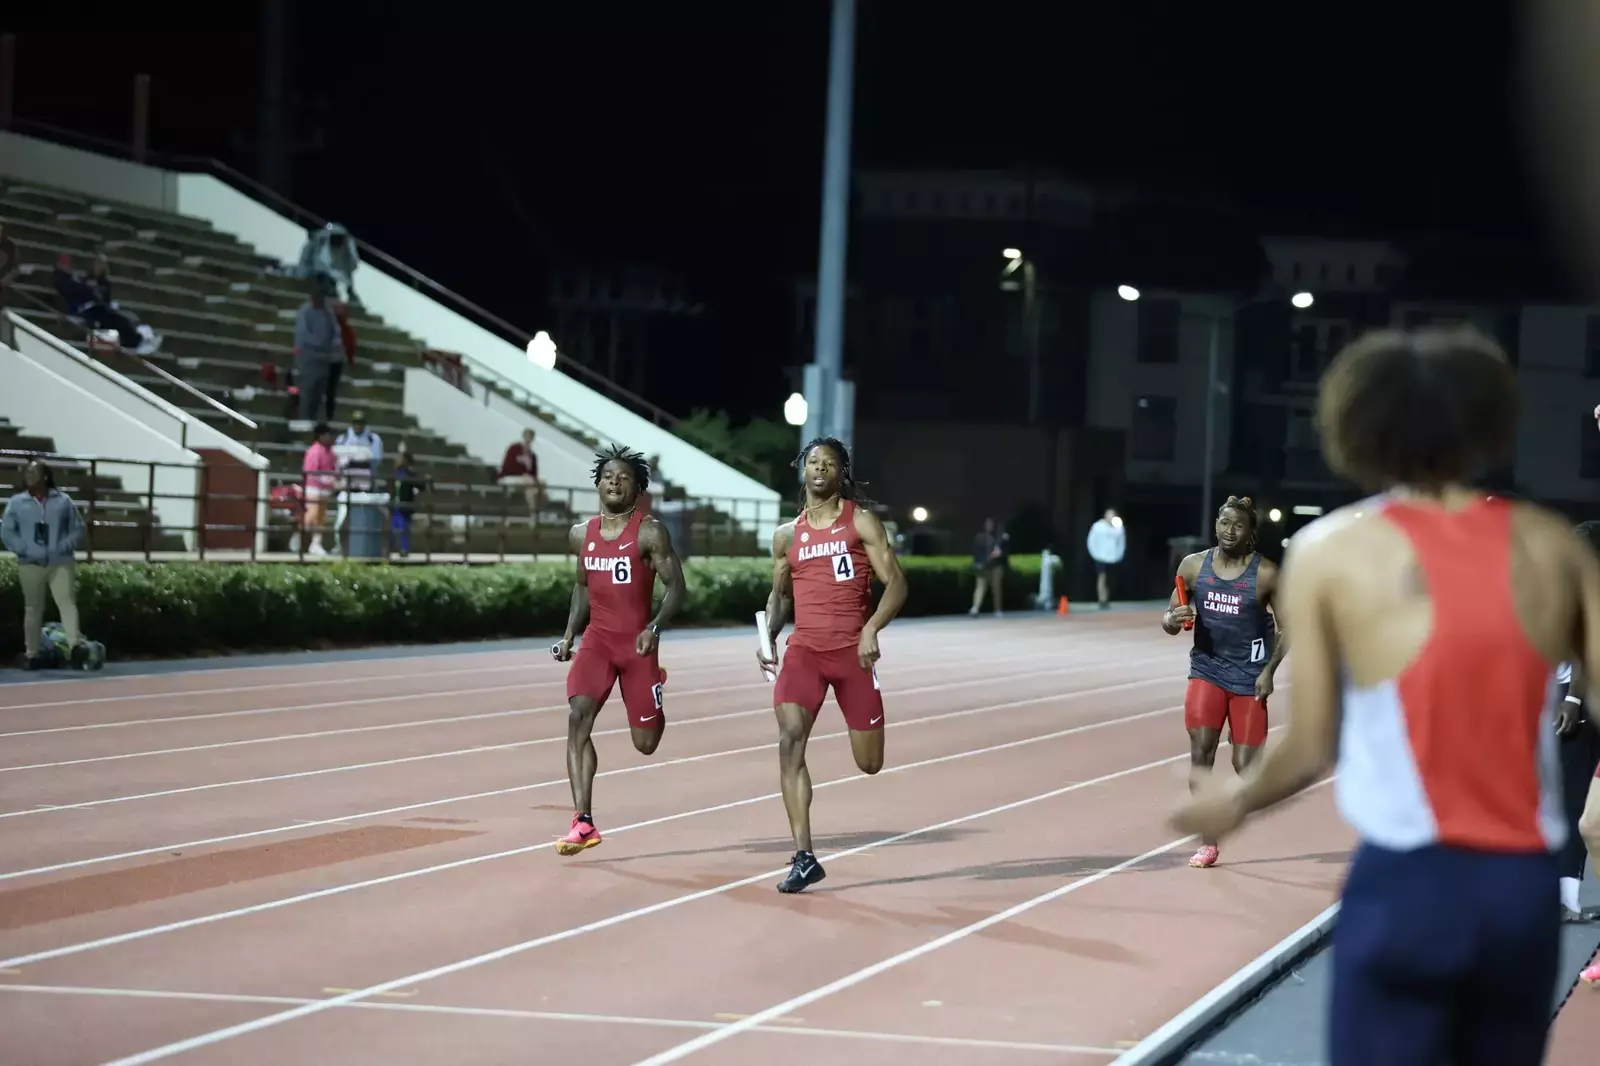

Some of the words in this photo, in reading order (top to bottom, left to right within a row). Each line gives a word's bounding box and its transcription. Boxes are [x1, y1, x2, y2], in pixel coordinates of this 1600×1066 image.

[798, 541, 848, 561] ALABAMA
[615, 561, 628, 582] 6
[837, 556, 851, 578] 4
[1203, 601, 1240, 615] CAJUNS
[1253, 640, 1262, 660] 7
[655, 684, 663, 706] 6
